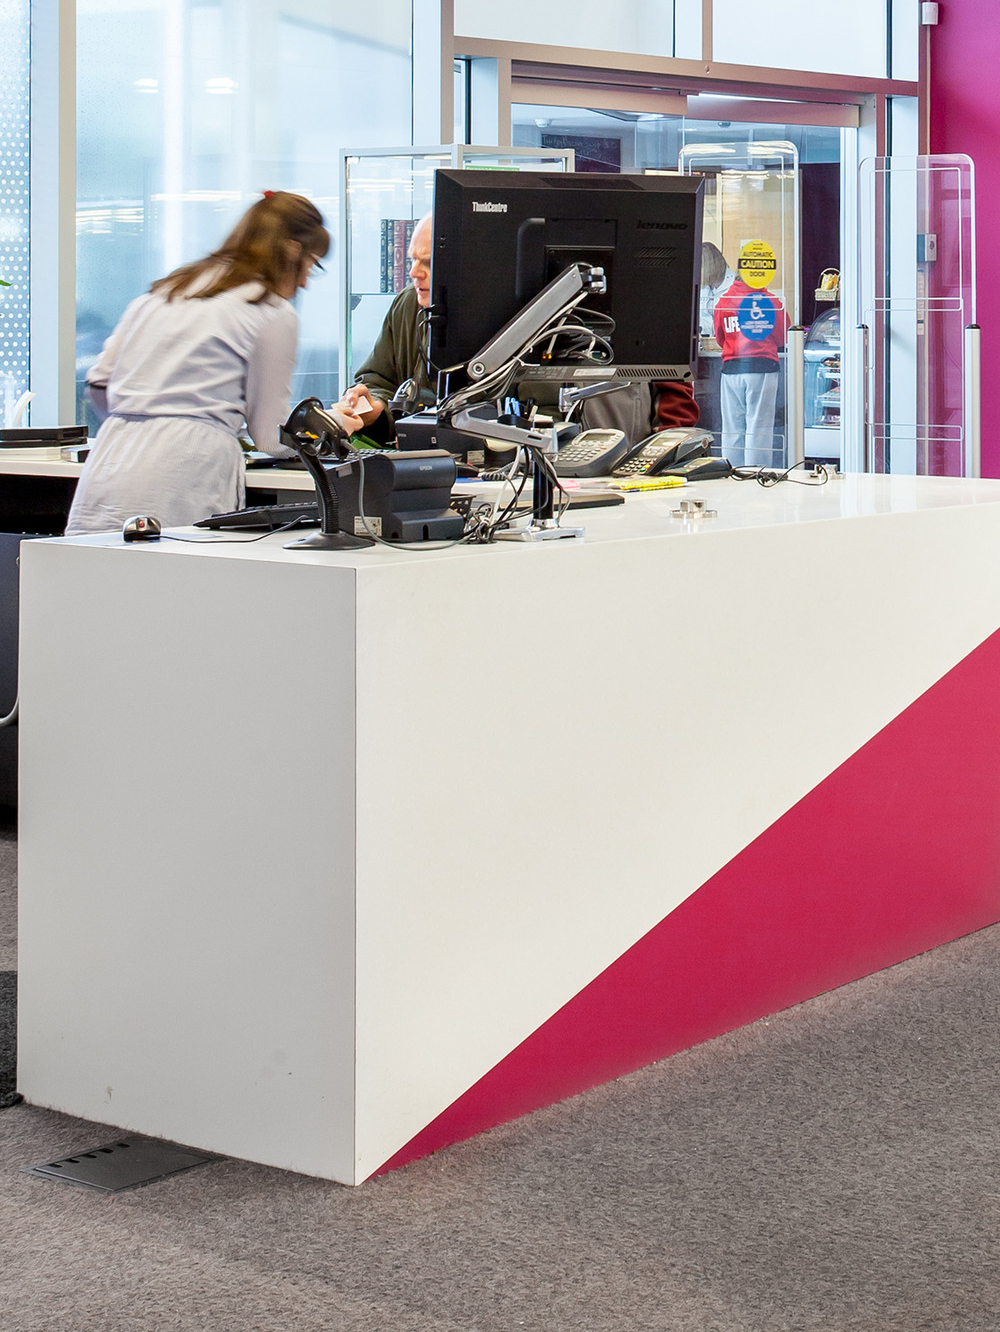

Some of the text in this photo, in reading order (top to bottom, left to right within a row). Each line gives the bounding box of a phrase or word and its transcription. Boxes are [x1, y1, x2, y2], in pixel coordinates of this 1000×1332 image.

[471, 201, 508, 213] ThinkCentre
[636, 220, 688, 230] lenovo
[741, 260, 775, 268] CAUTION
